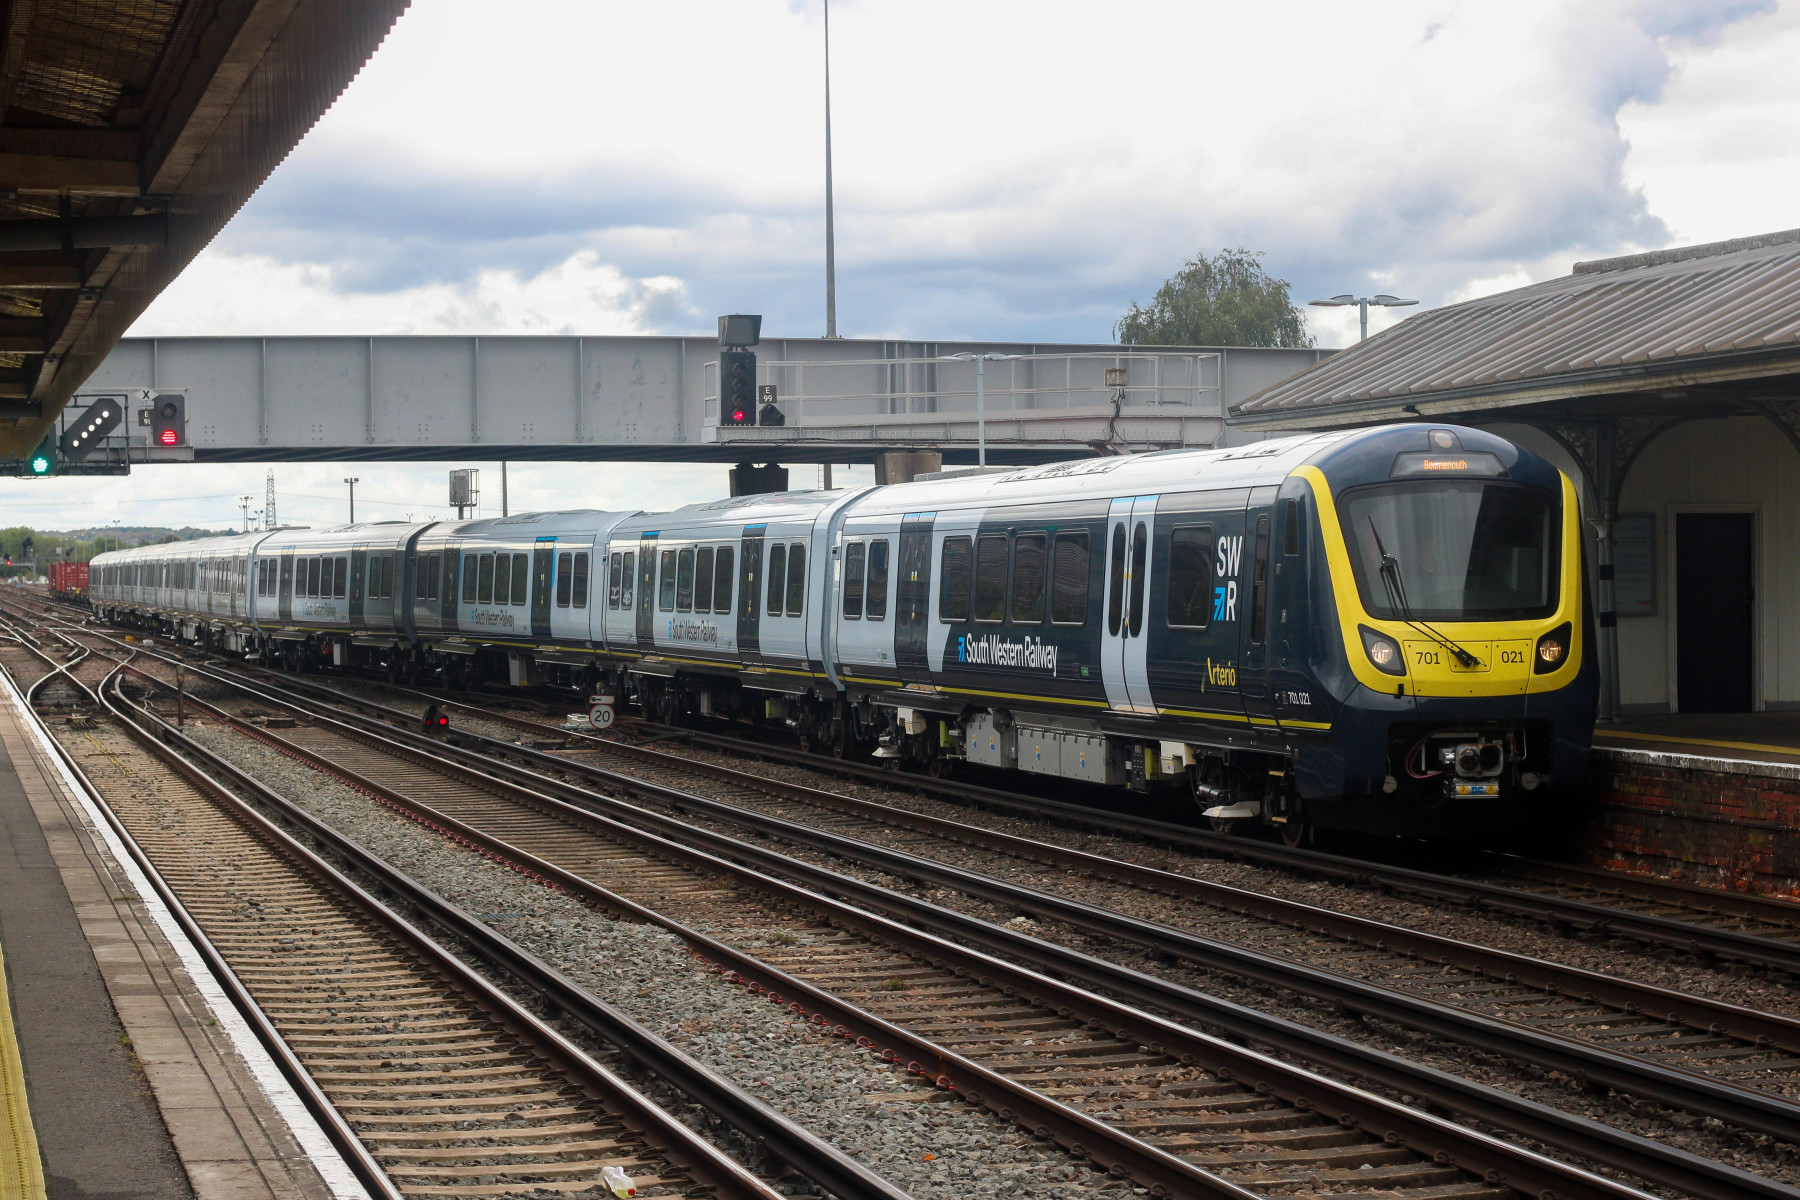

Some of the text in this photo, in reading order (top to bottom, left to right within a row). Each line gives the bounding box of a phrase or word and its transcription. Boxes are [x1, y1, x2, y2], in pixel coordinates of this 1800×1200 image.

[142, 390, 150, 400] X
[1423, 460, 1467, 470] Bournemouth
[1216, 535, 1243, 577] SW
[701, 620, 718, 648] Railway
[966, 632, 1058, 677] South Western Railway
[1416, 652, 1441, 665] 701
[1501, 651, 1525, 664] 021
[1287, 691, 1311, 705] 701 021
[594, 709, 611, 723] 20
